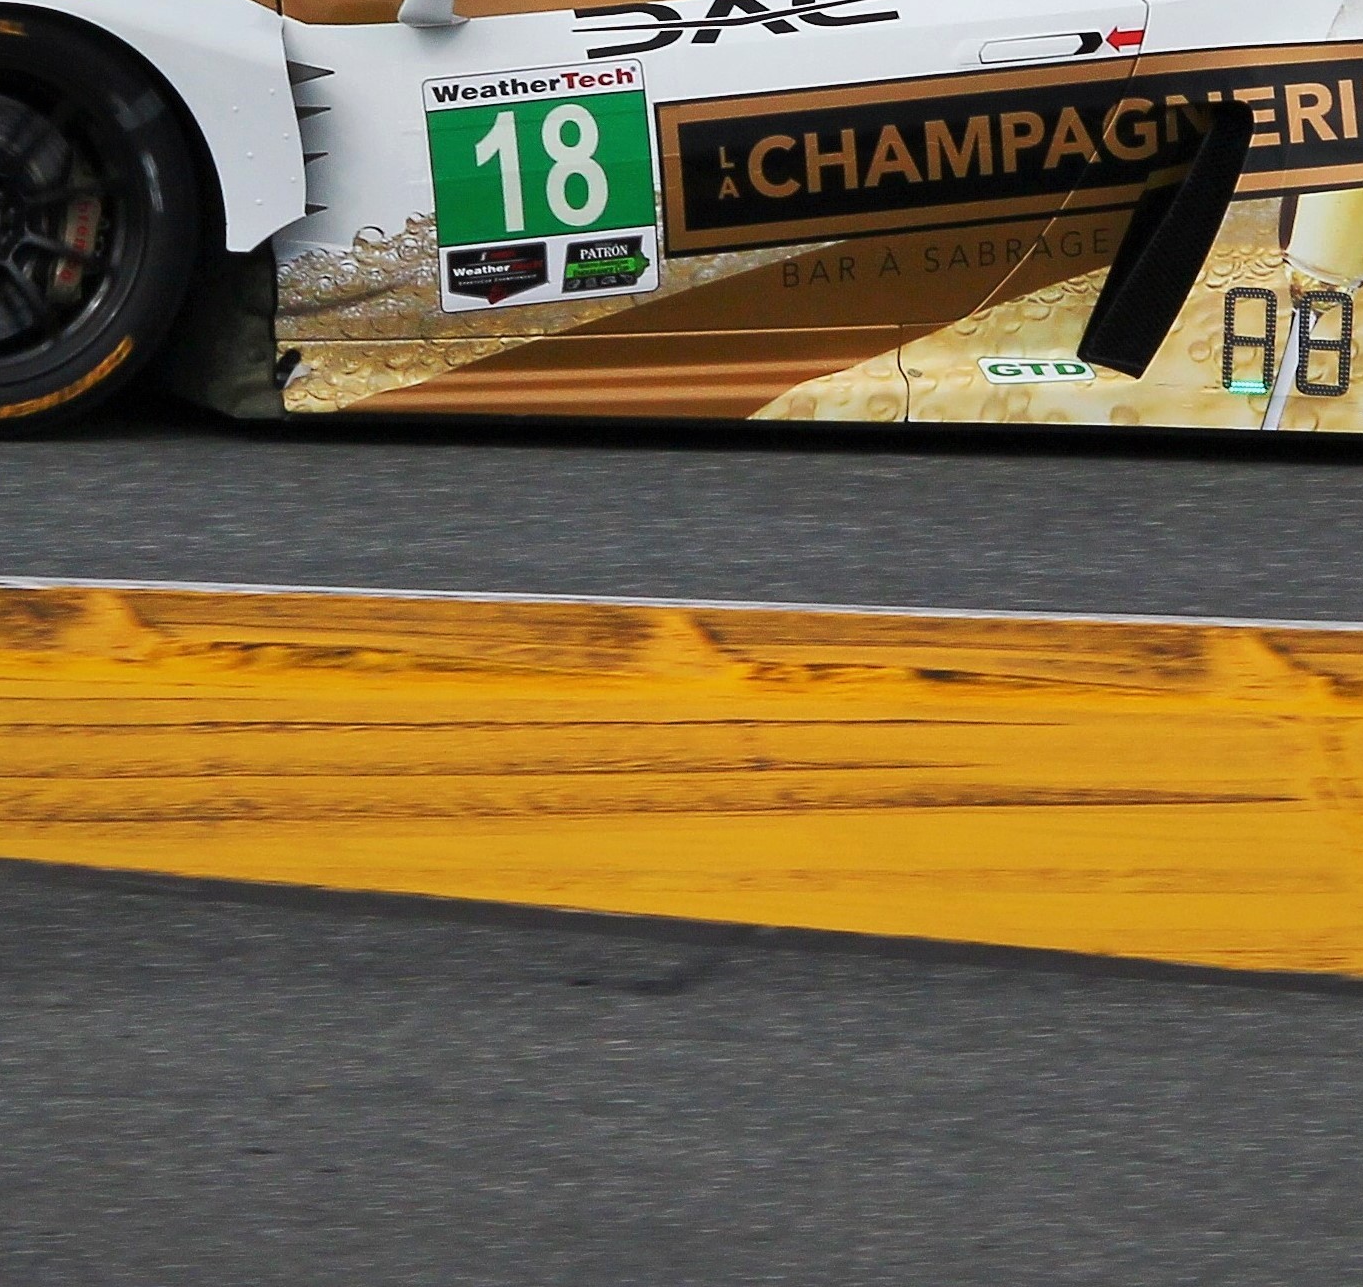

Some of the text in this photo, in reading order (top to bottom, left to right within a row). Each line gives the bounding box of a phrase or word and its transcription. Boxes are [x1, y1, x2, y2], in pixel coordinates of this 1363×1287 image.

[432, 68, 634, 103] WeatherTech
[474, 103, 609, 233] 18
[580, 244, 629, 260] PATRÓN
[782, 228, 1111, 289] BAR À SABRAGE
[987, 362, 1086, 378] GTD
